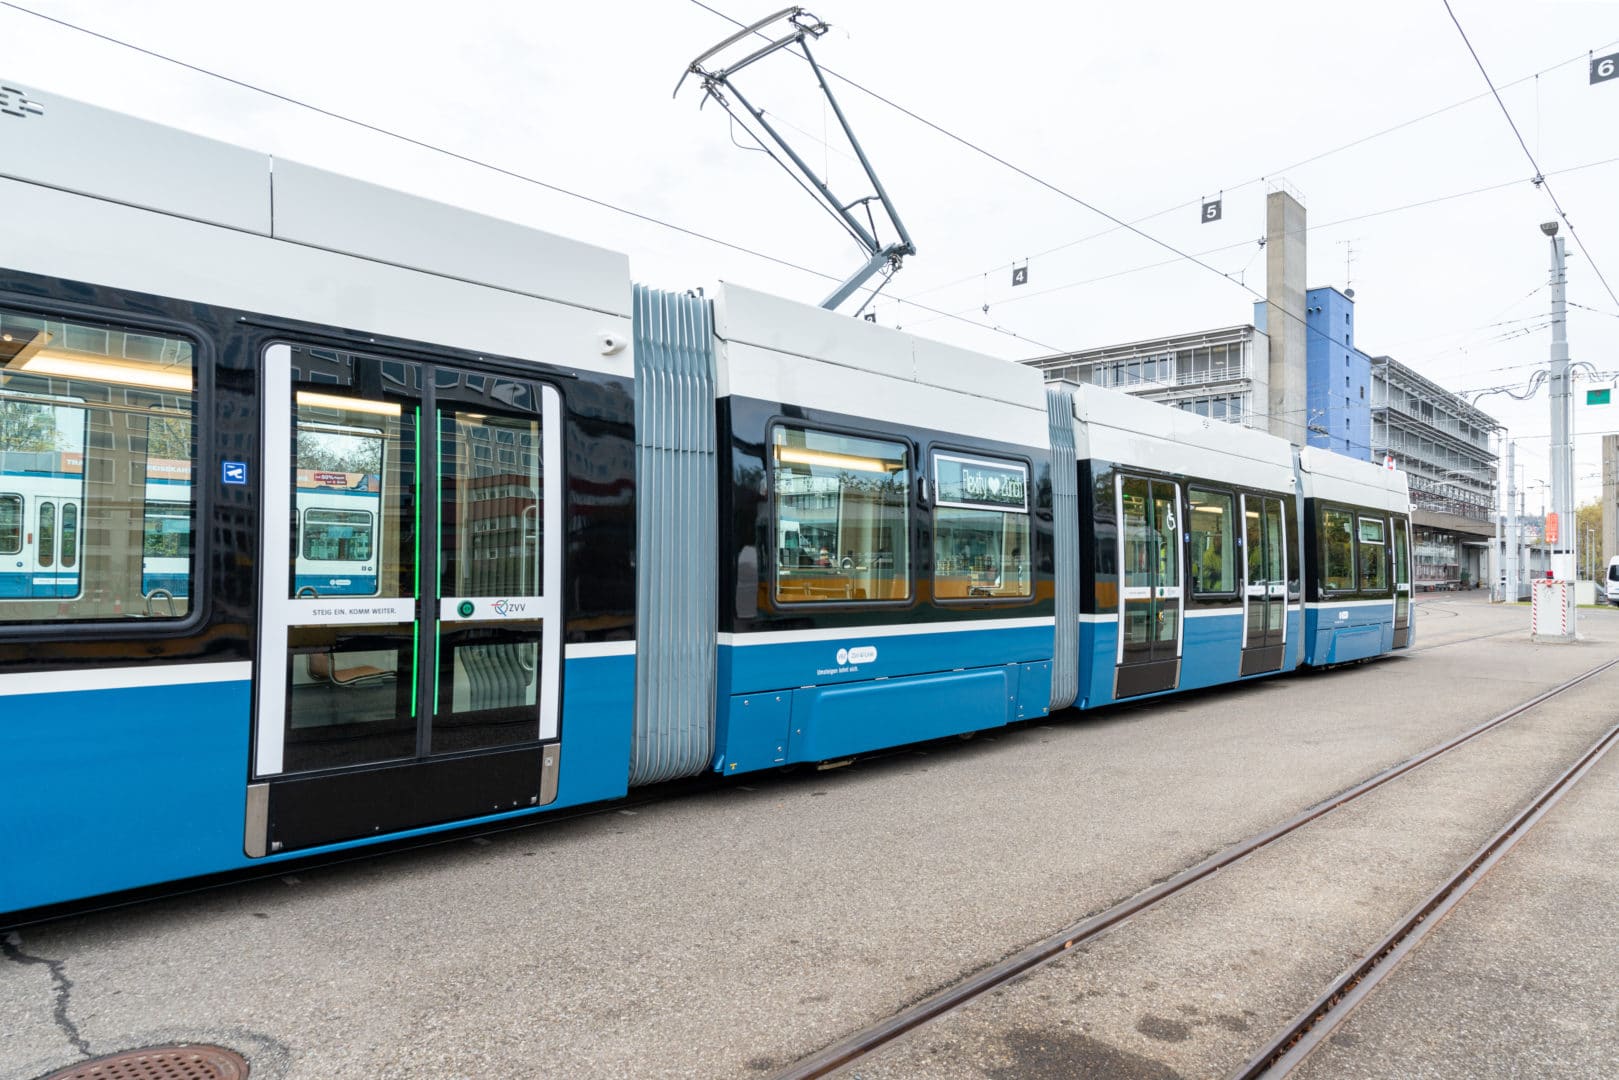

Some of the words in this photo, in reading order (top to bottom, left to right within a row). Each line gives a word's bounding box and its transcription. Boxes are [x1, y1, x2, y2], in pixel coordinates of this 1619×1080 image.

[1598, 59, 1614, 77] 6
[1207, 204, 1217, 219] 5
[1015, 270, 1024, 282] 4
[312, 608, 332, 616] STEIG
[334, 608, 347, 616] EIN.
[349, 607, 370, 615] KOMM
[509, 603, 526, 612] ZVV
